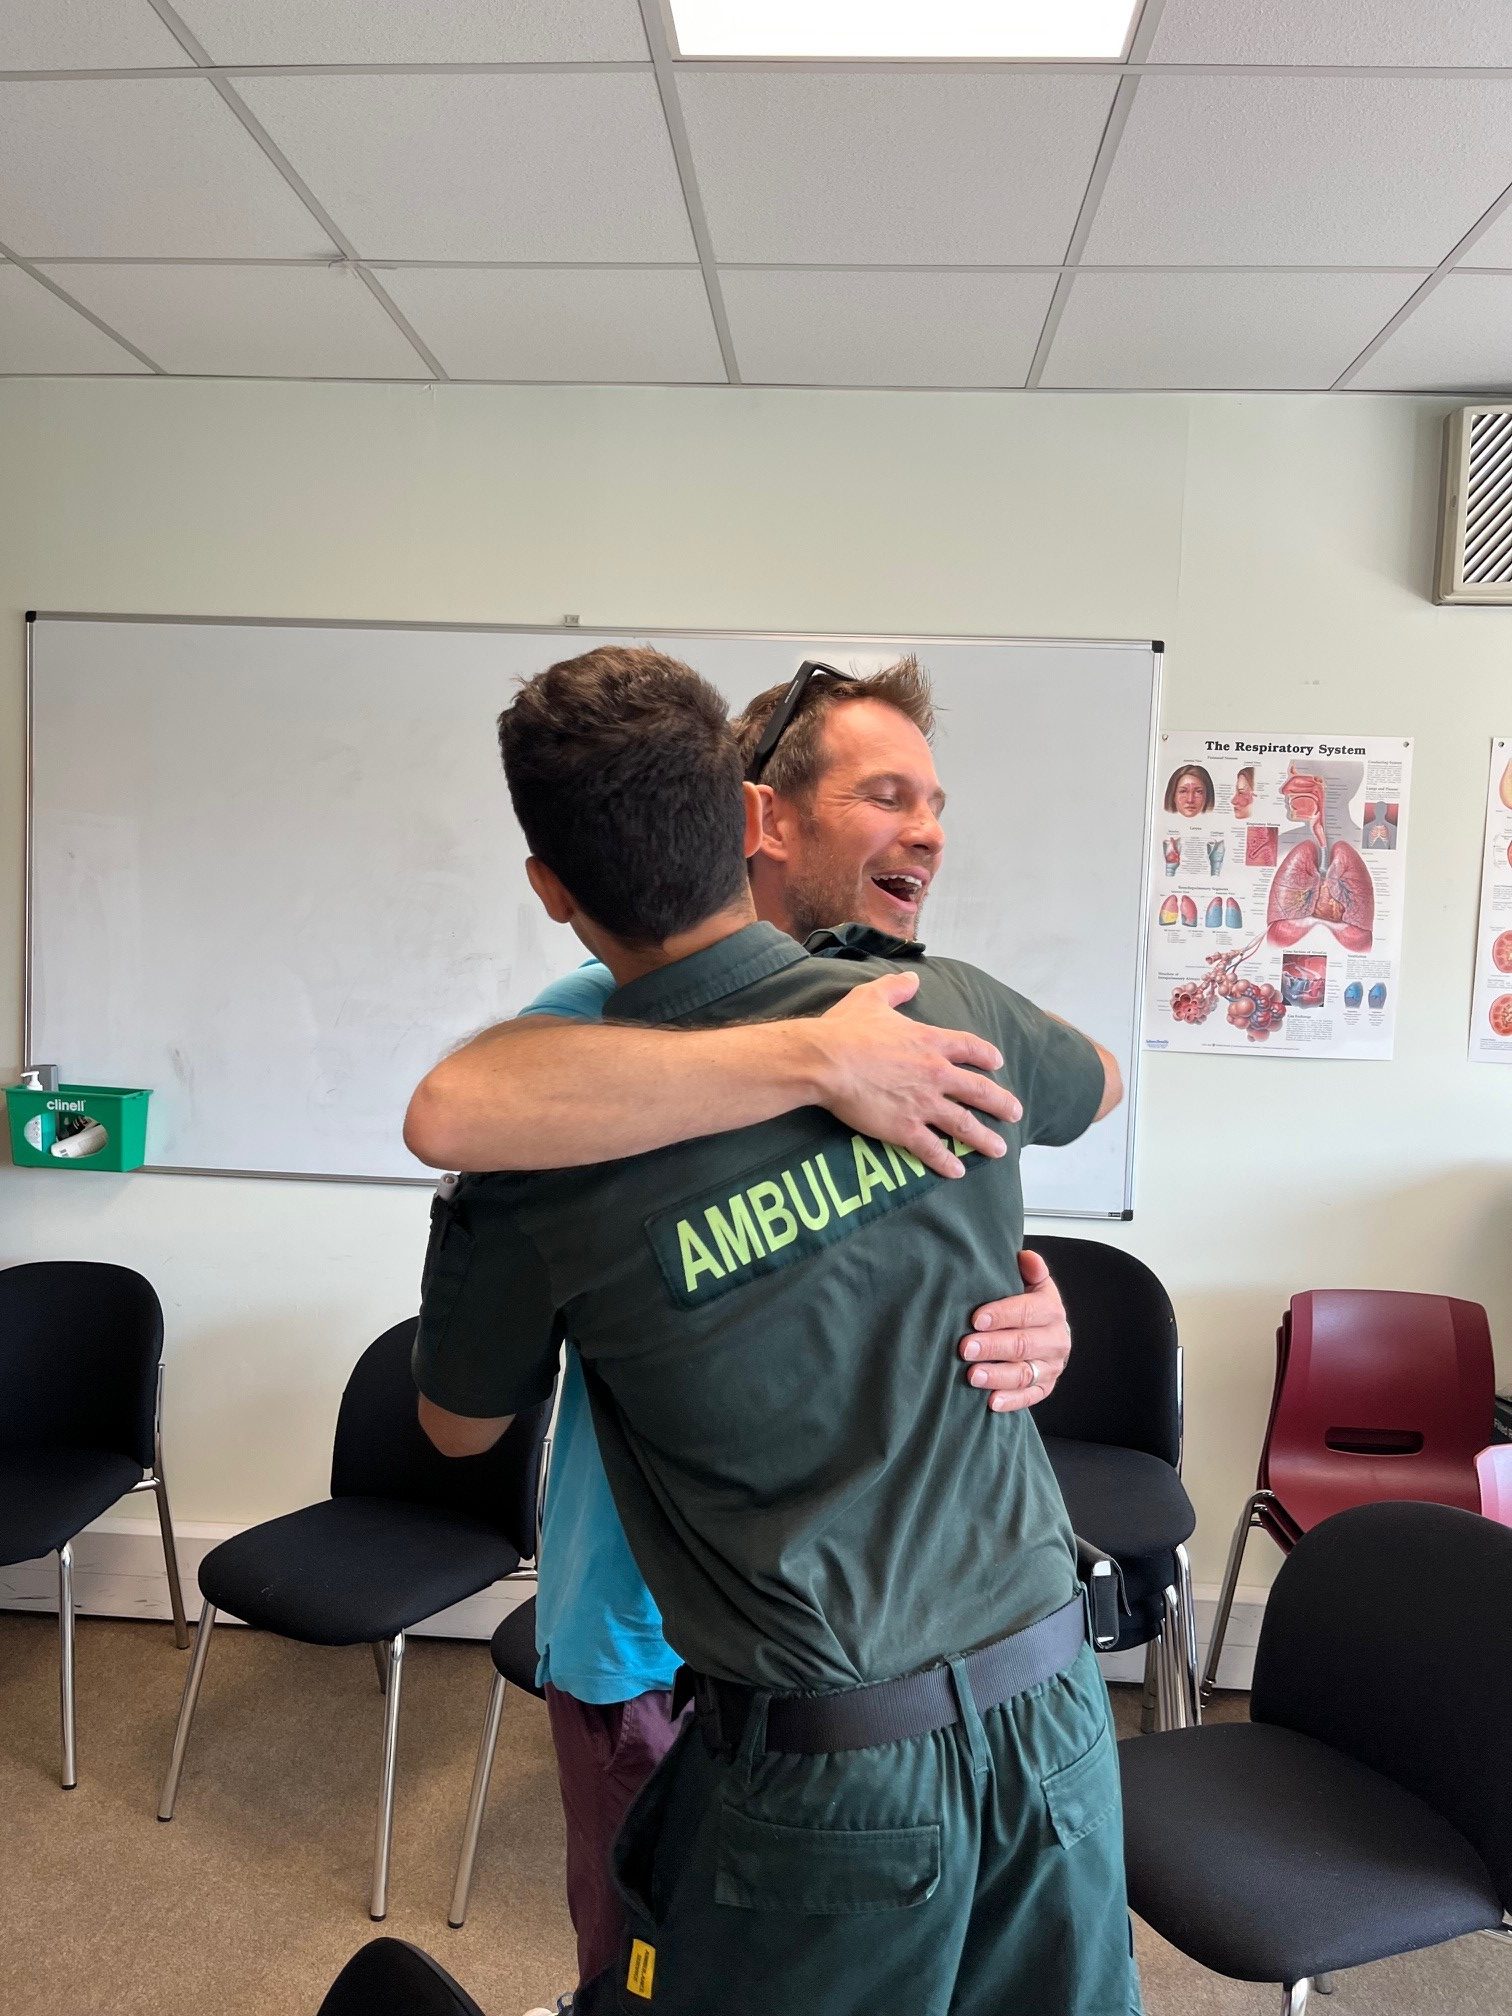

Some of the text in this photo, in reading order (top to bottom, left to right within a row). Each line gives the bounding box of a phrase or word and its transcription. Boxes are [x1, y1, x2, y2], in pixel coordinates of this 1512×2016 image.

[1205, 741, 1366, 757] The Respiratory System
[46, 1098, 85, 1112] clinell
[676, 1134, 977, 1292] AMBULAN
